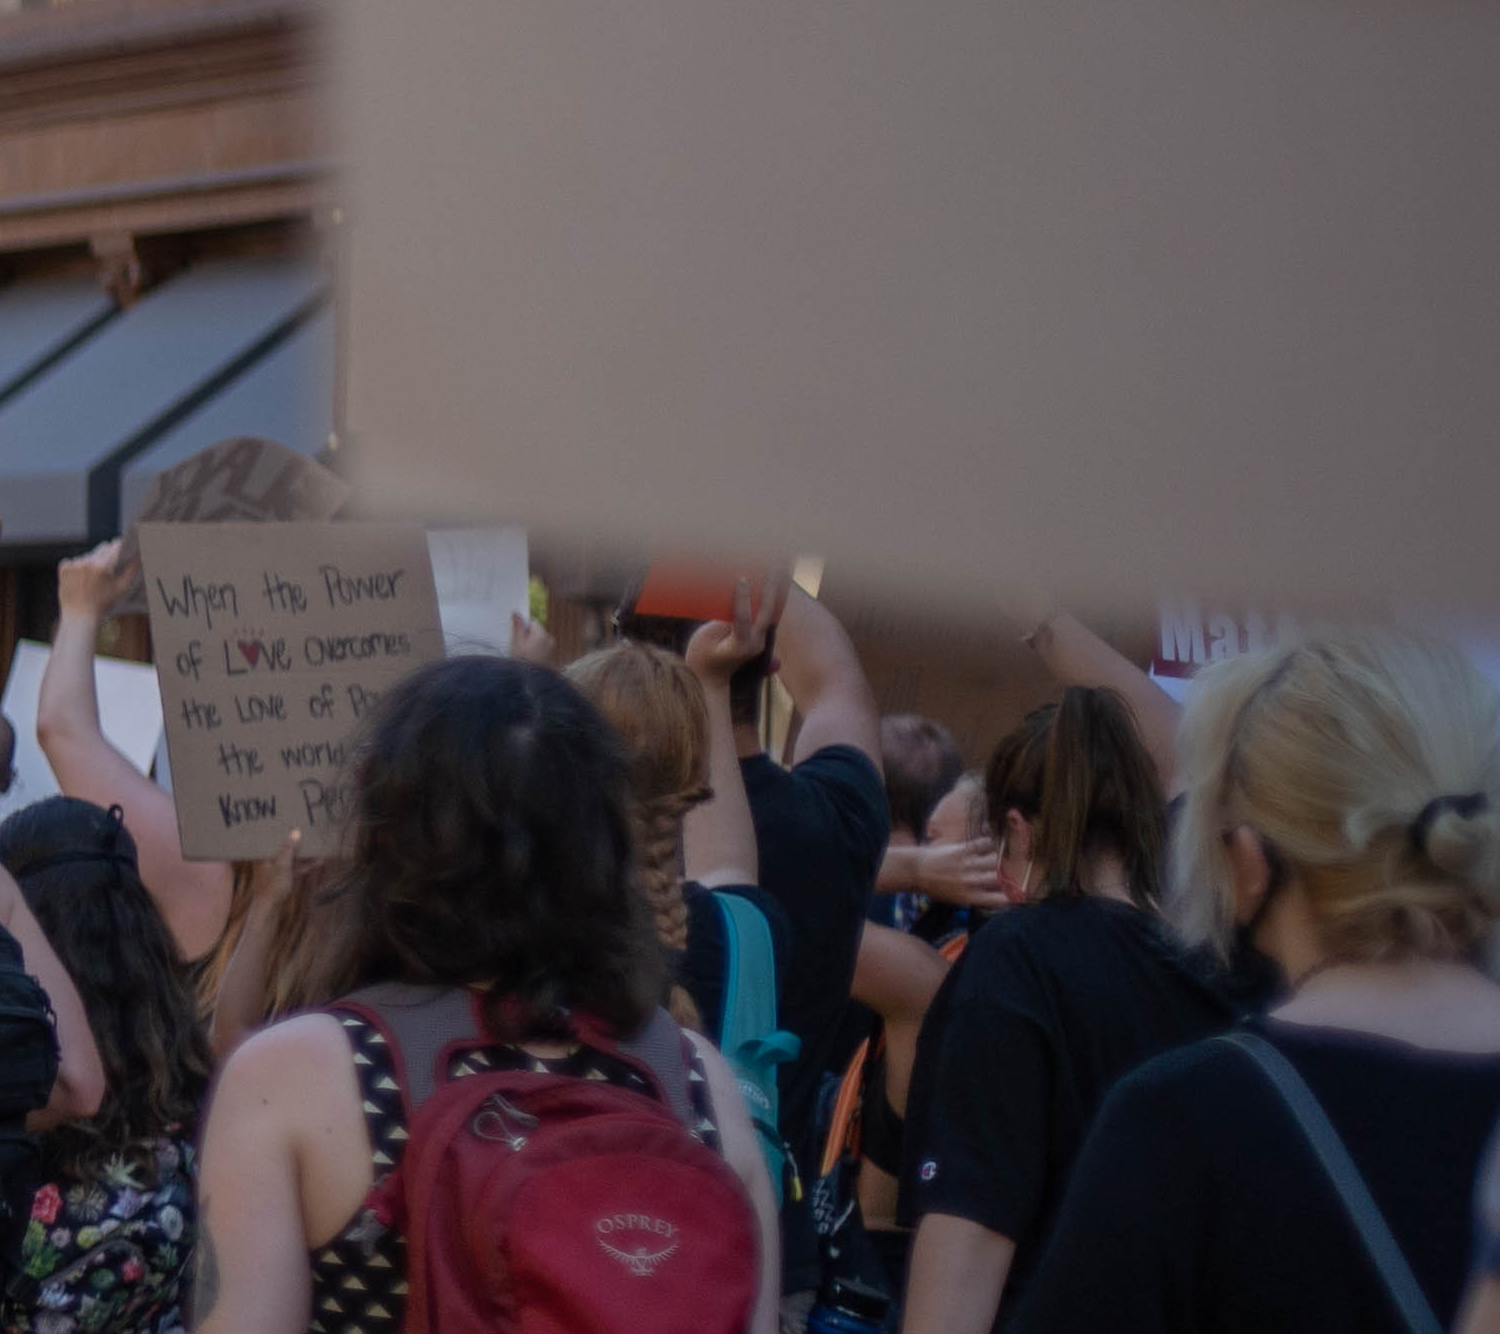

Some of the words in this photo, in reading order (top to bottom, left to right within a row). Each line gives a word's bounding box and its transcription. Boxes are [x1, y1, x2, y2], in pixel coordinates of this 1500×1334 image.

[157, 574, 238, 629] When
[264, 571, 307, 614] the
[319, 565, 404, 607] Power
[176, 642, 202, 680] of
[182, 698, 221, 730] the
[309, 684, 334, 718] of
[220, 745, 263, 777] the
[219, 792, 276, 827] Know
[596, 1214, 677, 1238] OSPREY
